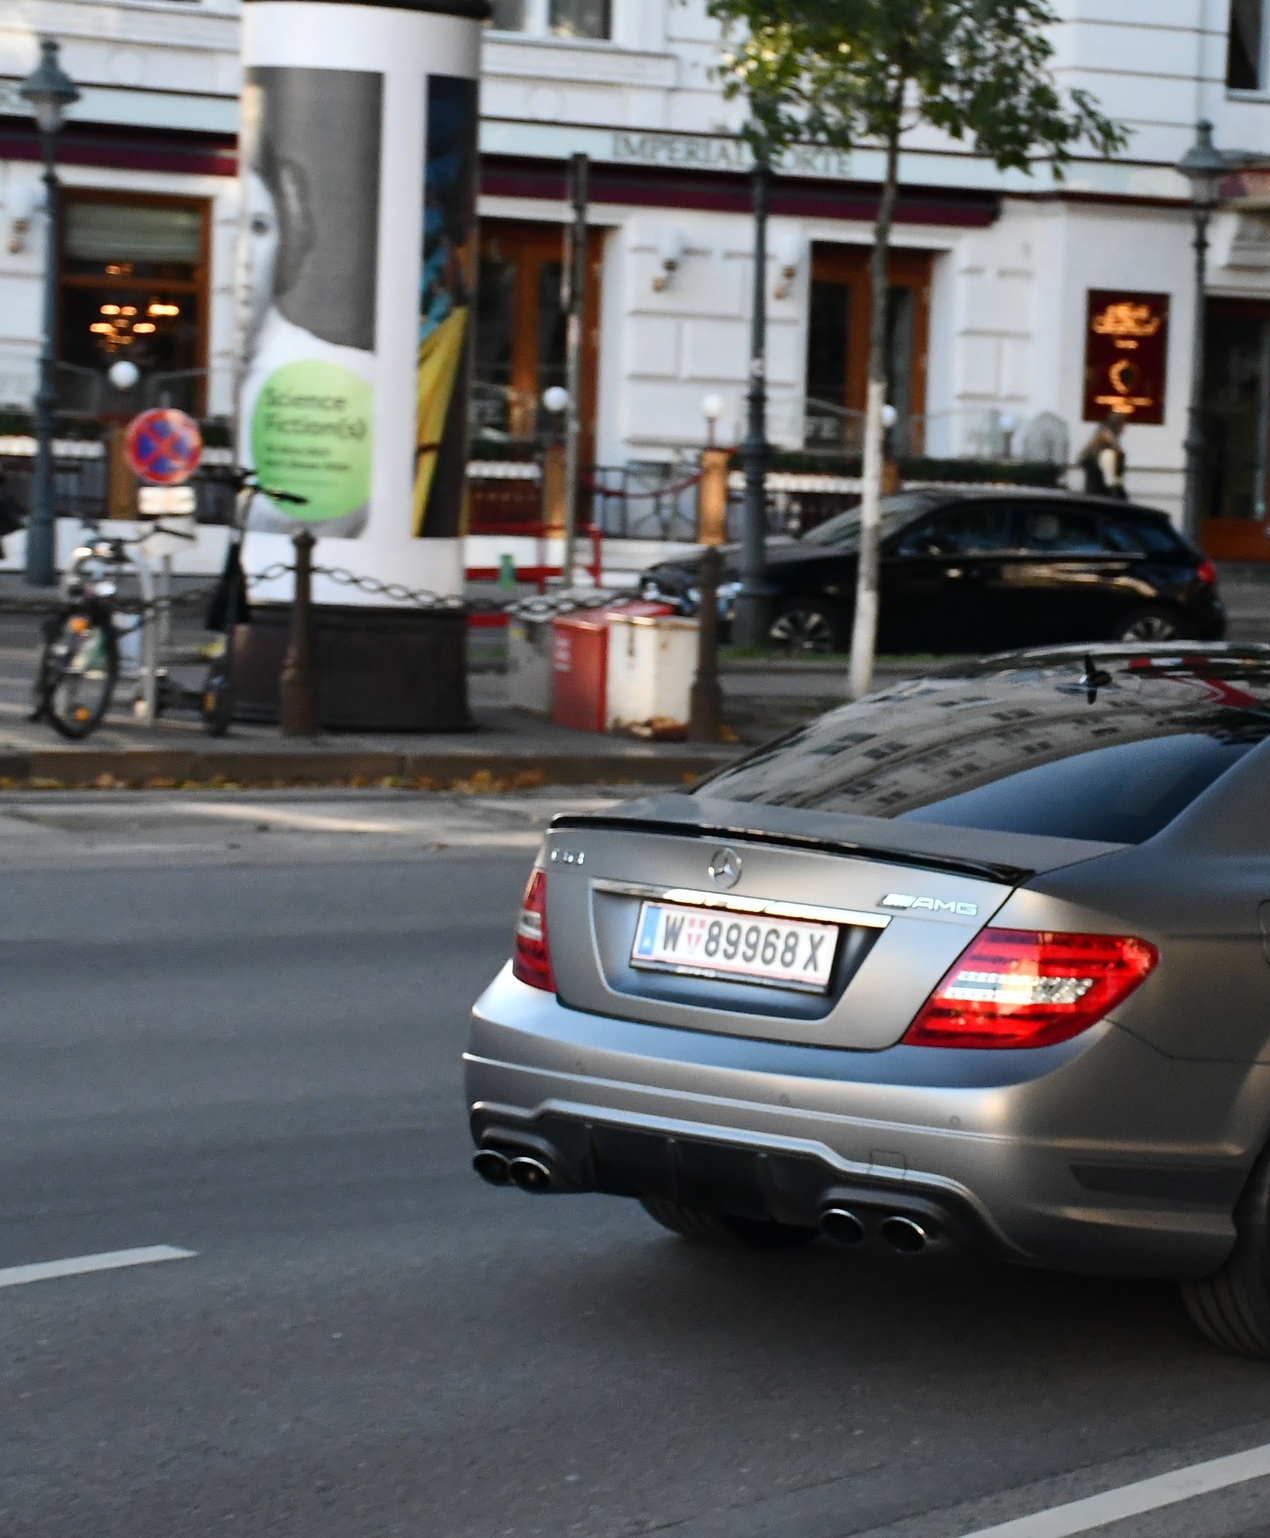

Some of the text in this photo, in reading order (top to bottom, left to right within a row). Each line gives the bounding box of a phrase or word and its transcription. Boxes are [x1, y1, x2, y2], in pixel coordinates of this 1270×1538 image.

[911, 896, 978, 916] AMG
[662, 914, 825, 973] W 89968 X
